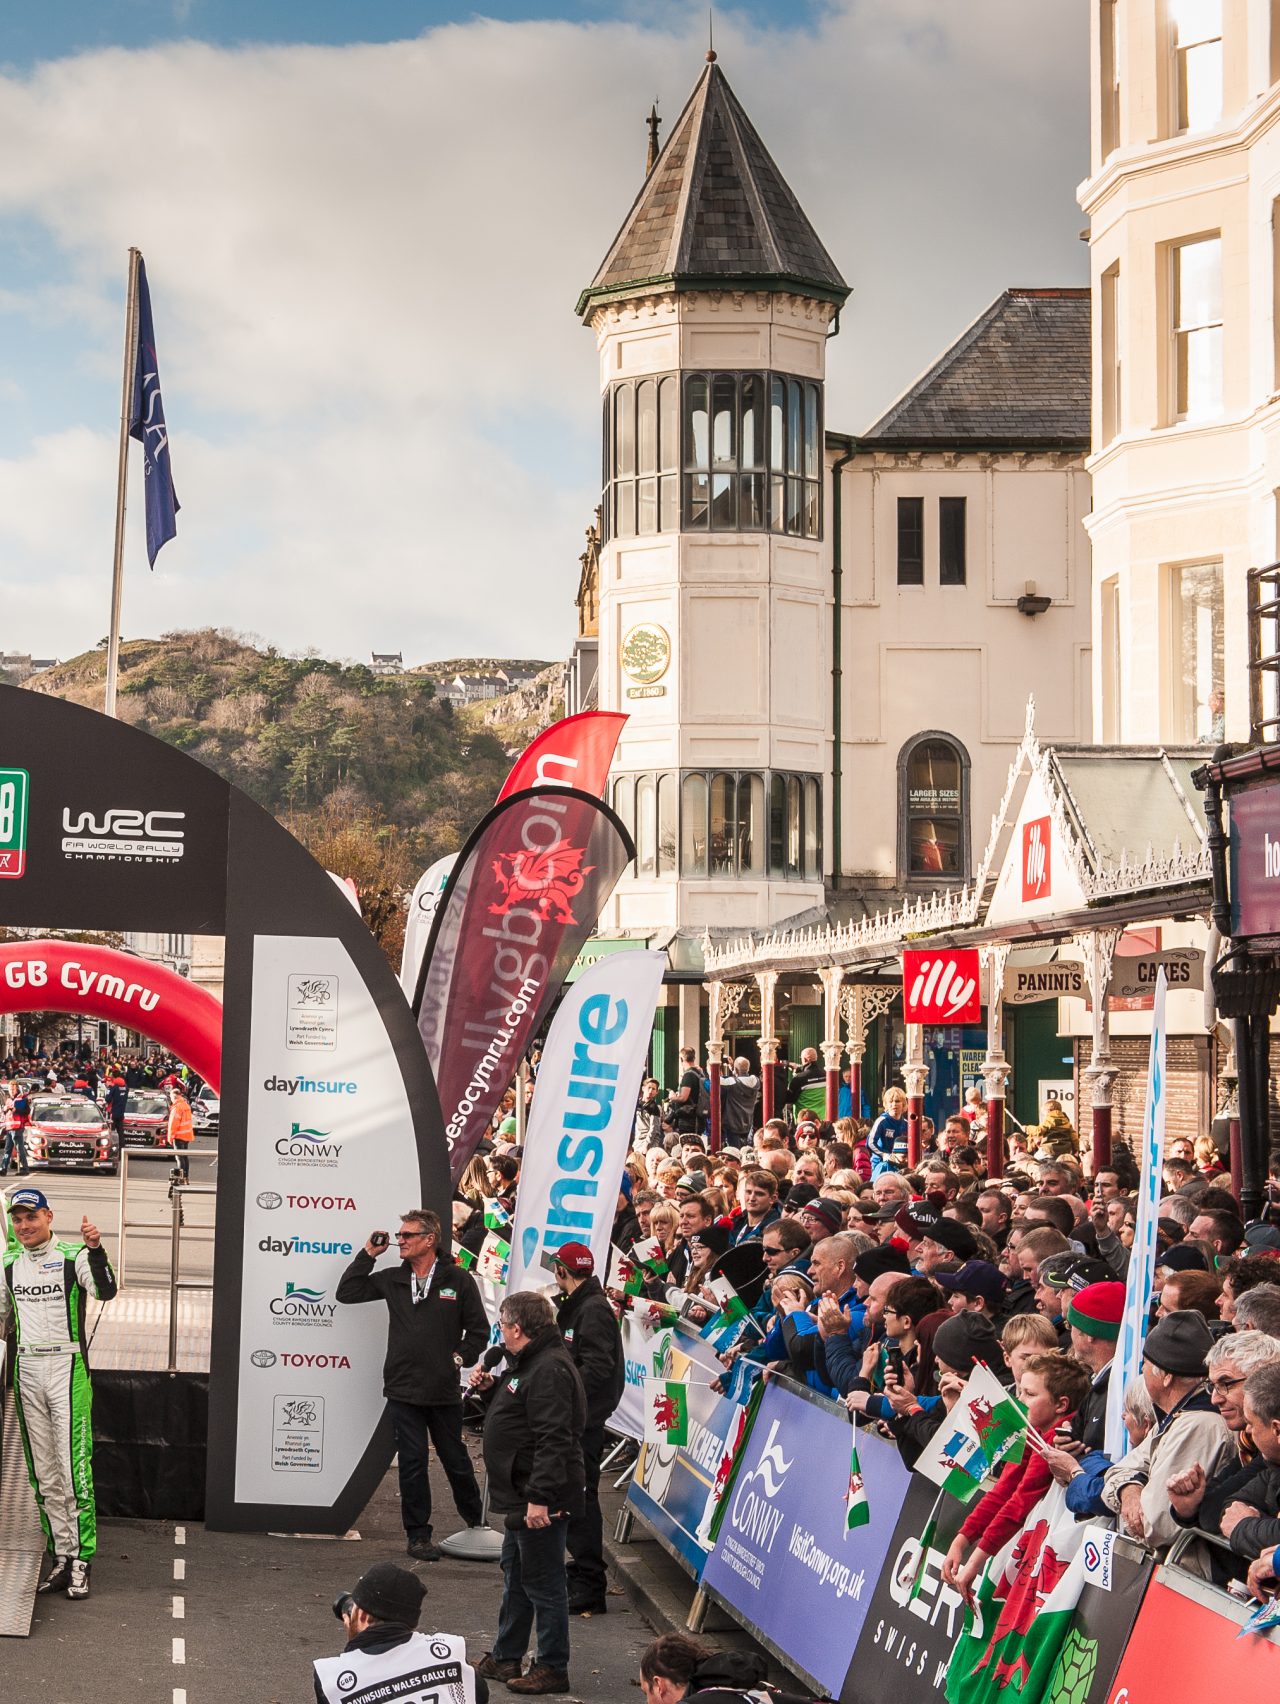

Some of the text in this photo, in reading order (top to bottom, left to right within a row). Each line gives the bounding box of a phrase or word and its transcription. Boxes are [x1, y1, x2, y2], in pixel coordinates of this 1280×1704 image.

[910, 789, 959, 797] LARGER SIZES
[62, 807, 185, 838] WRC
[66, 841, 180, 853] FIA WORLD RALLY
[65, 853, 180, 864] CHAMPIONSHIP
[5, 960, 48, 988] GB
[61, 960, 160, 1012] Cymru
[908, 958, 976, 1018] illy
[1018, 972, 1082, 992] PANINI'S
[962, 1052, 986, 1062] WAREH
[263, 1075, 357, 1096] dayinsure
[543, 993, 628, 1250] insure
[275, 1138, 342, 1158] CONWY
[286, 1195, 357, 1210] TOYOTA
[258, 1235, 352, 1256] dayinsure
[14, 1284, 63, 1296] ŠKODA
[269, 1297, 337, 1317] CONWY
[280, 1353, 351, 1369] TOYOTA
[624, 1360, 647, 1387] sure
[732, 1470, 785, 1553] CONWY
[1103, 1533, 1113, 1556] DAB
[788, 1523, 865, 1601] VisitConwy.org.uk
[874, 1619, 928, 1675] SWISS
[340, 1675, 354, 1687] GBR
[391, 1678, 421, 1693] WALES
[422, 1670, 446, 1684] RALLY
[447, 1667, 458, 1677] GB
